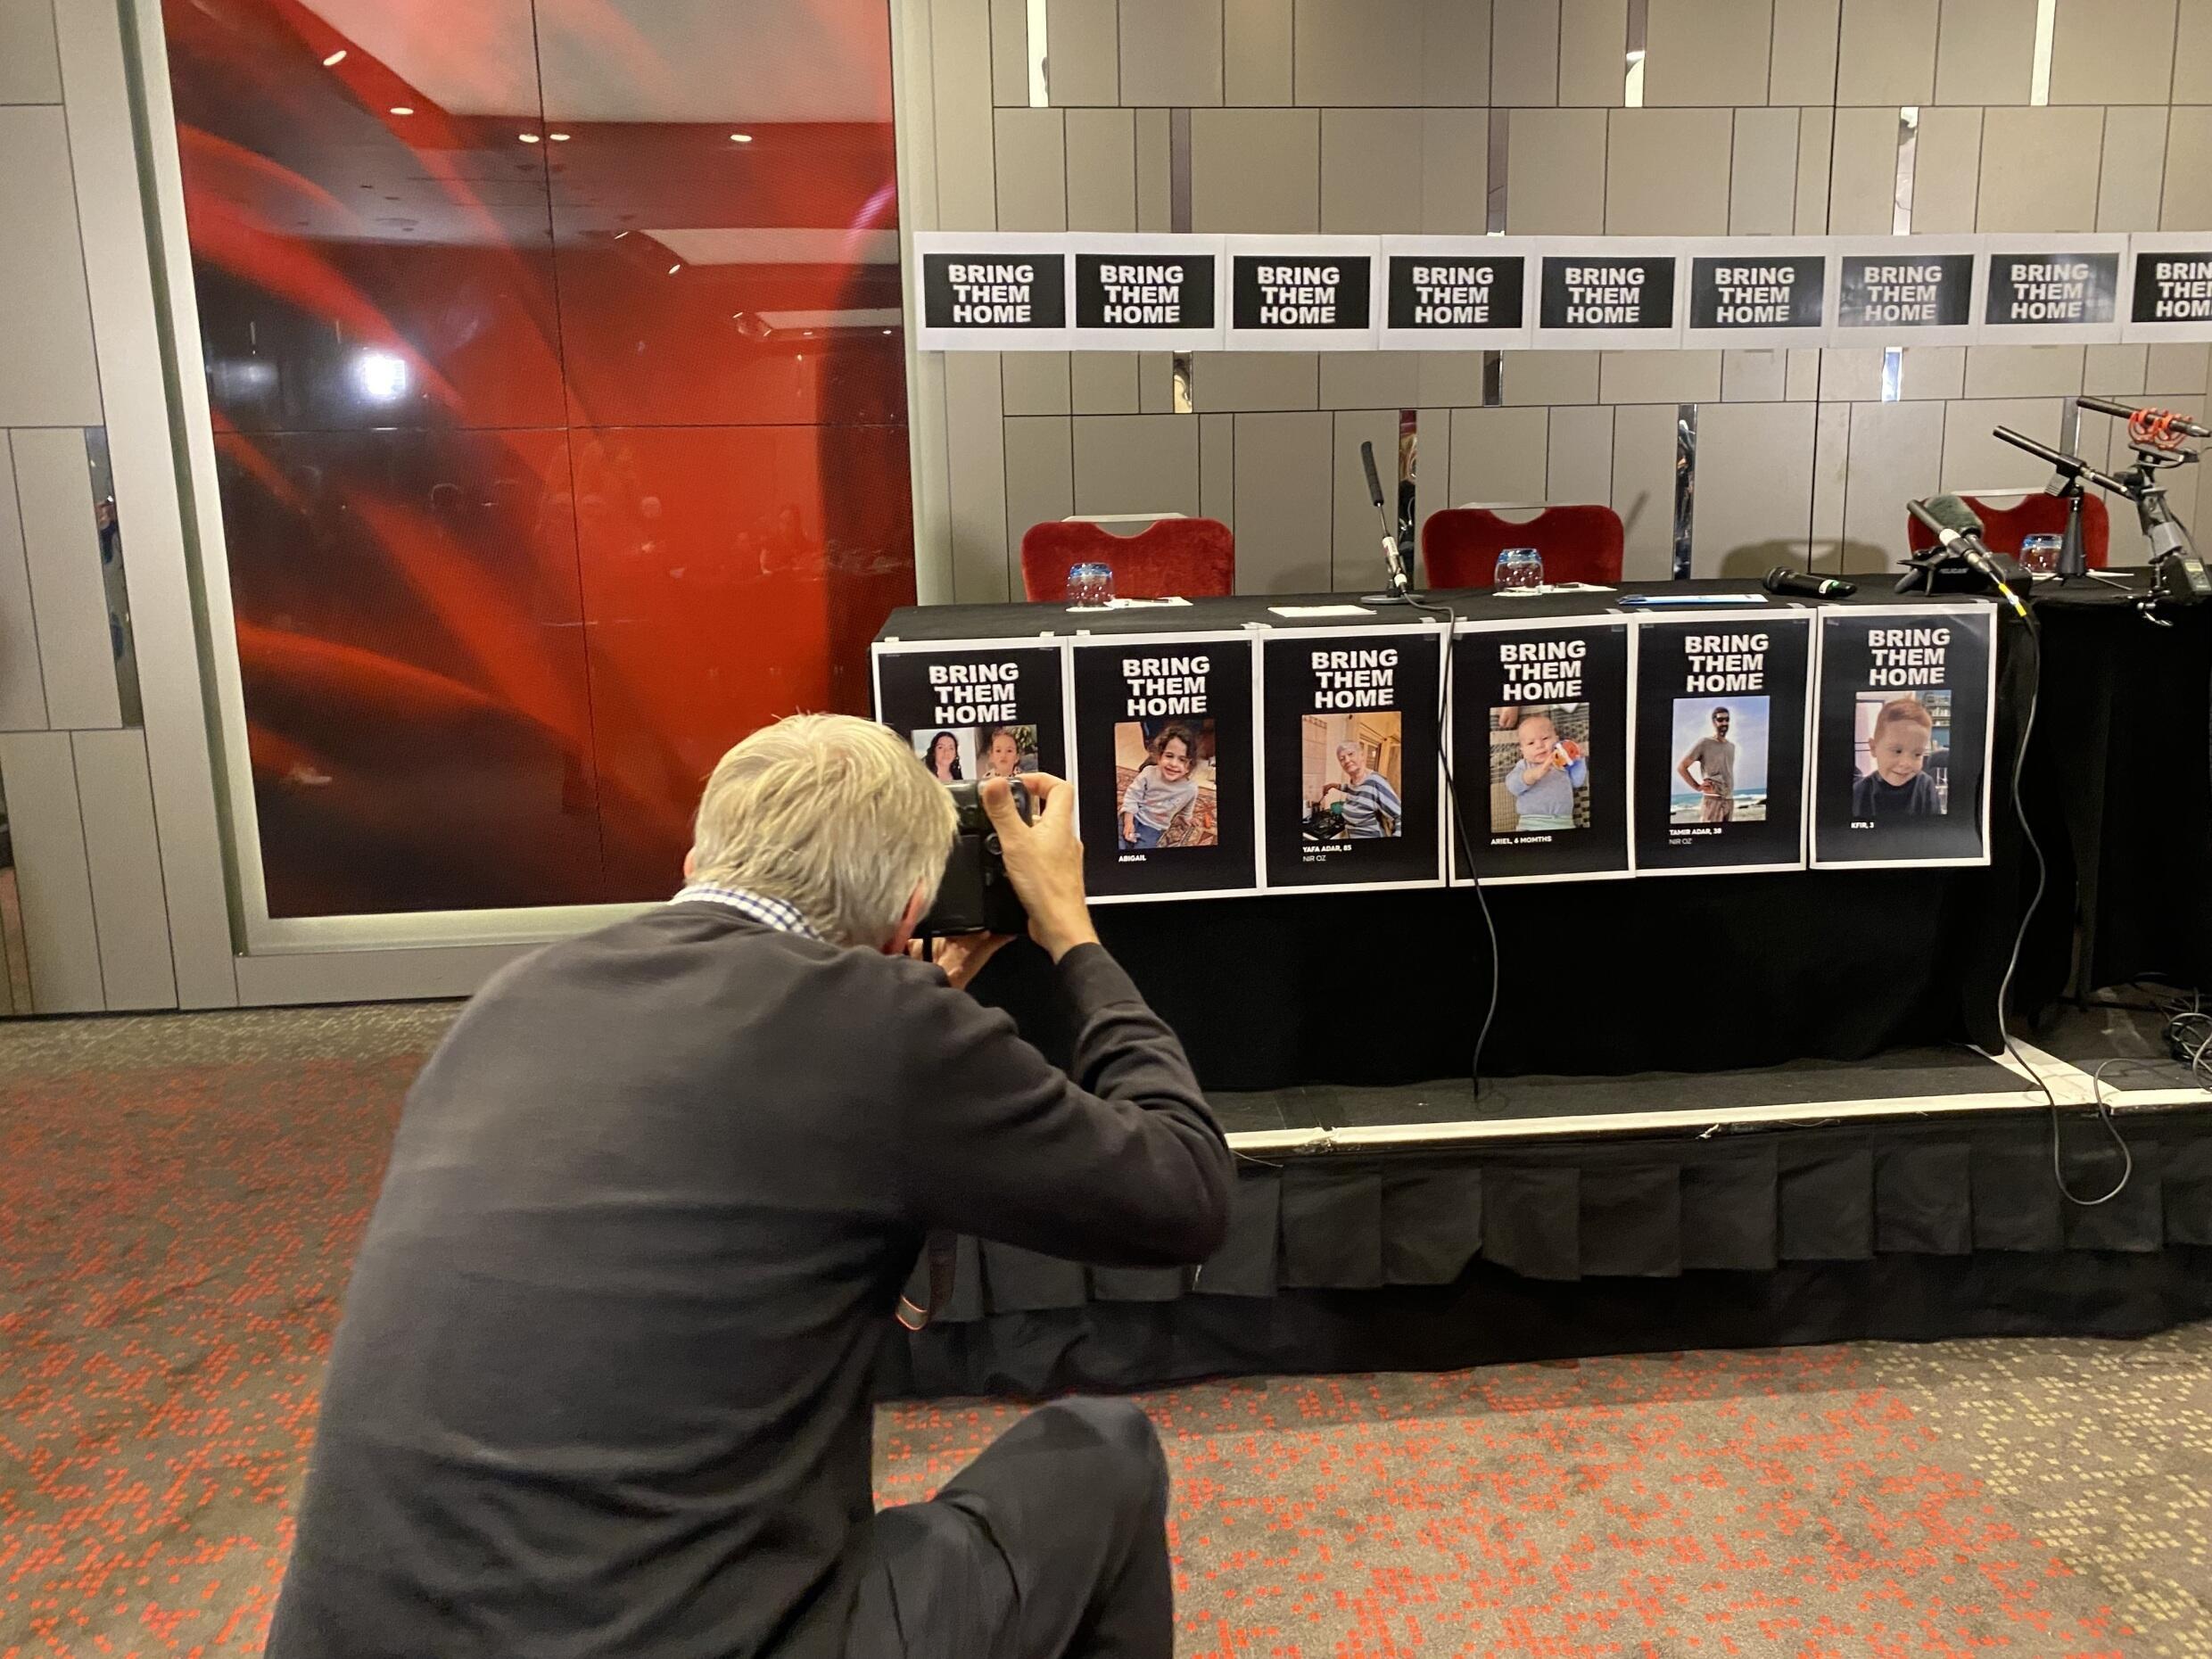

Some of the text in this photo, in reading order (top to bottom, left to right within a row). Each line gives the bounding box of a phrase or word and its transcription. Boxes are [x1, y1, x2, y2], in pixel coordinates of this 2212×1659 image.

[948, 264, 1035, 284] BRING
[1100, 264, 1184, 285] BRING
[1257, 266, 1341, 285] BRING
[1412, 266, 1494, 285] BRING
[1564, 267, 1645, 285] BRING
[1714, 267, 1795, 285] BRING
[1863, 265, 1943, 285] BRING
[2010, 263, 2089, 282] BRING
[2156, 261, 2212, 280] BRIN
[953, 285, 1030, 303] THEM
[1103, 285, 1179, 304] THEM
[1260, 285, 1335, 305] THEM
[1416, 285, 1490, 304] THEM
[1568, 286, 1640, 305] THEM
[1718, 285, 1790, 304] THEM
[1866, 285, 1937, 303] THEM
[2013, 283, 2084, 301] THEM
[2158, 281, 2212, 299] THE
[953, 304, 1032, 324] HOME
[1103, 304, 1181, 324] HOME
[1260, 306, 1336, 325] HOME
[1415, 305, 1490, 325] HOME
[1566, 306, 1640, 324] HOME
[1716, 305, 1790, 324] HOME
[1864, 303, 1937, 322] HOME
[2010, 301, 2083, 320] HOME
[2156, 300, 2212, 318] HOM
[1685, 633, 1769, 654] BRING
[1868, 628, 1951, 648] BRING
[1311, 648, 1399, 670] BRING
[1499, 640, 1587, 663] BRING
[1871, 648, 1945, 666] THEM
[1122, 656, 1210, 678] BRING
[1503, 660, 1581, 681] THEM
[1688, 653, 1764, 673] THEM
[929, 662, 1019, 685] BRING
[1315, 668, 1393, 689] THEM
[1686, 673, 1764, 693] HOME
[1869, 666, 1945, 686] HOME
[934, 682, 1015, 704] THEM
[1127, 676, 1206, 697] THEM
[1503, 679, 1582, 701] HOME
[1127, 695, 1207, 717] HOME
[1315, 688, 1394, 709] HOME
[934, 703, 1017, 724] HOME
